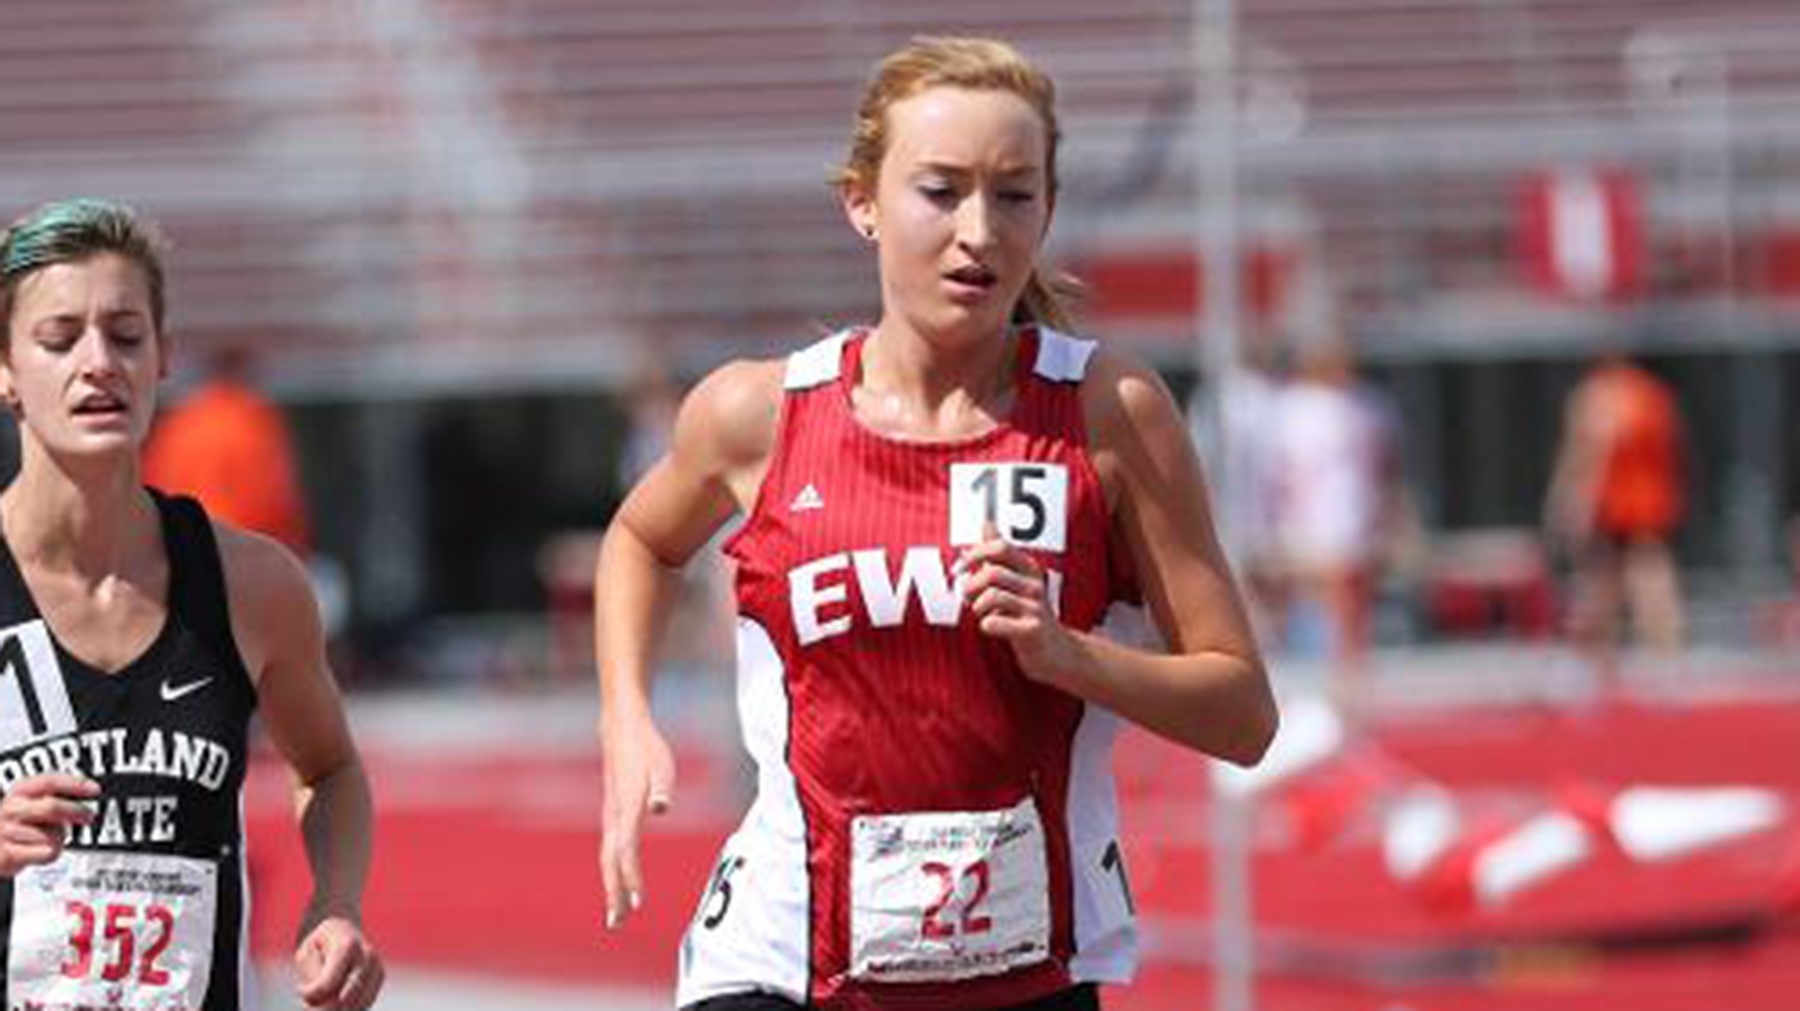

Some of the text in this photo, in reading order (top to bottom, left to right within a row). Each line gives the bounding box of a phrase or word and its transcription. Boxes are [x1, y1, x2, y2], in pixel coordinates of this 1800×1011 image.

[970, 466, 1047, 542] 15
[788, 545, 1062, 646] EW
[0, 728, 229, 791] PORTLAND
[62, 797, 178, 846] TATE
[920, 859, 993, 940] 22
[61, 901, 176, 987] 352
